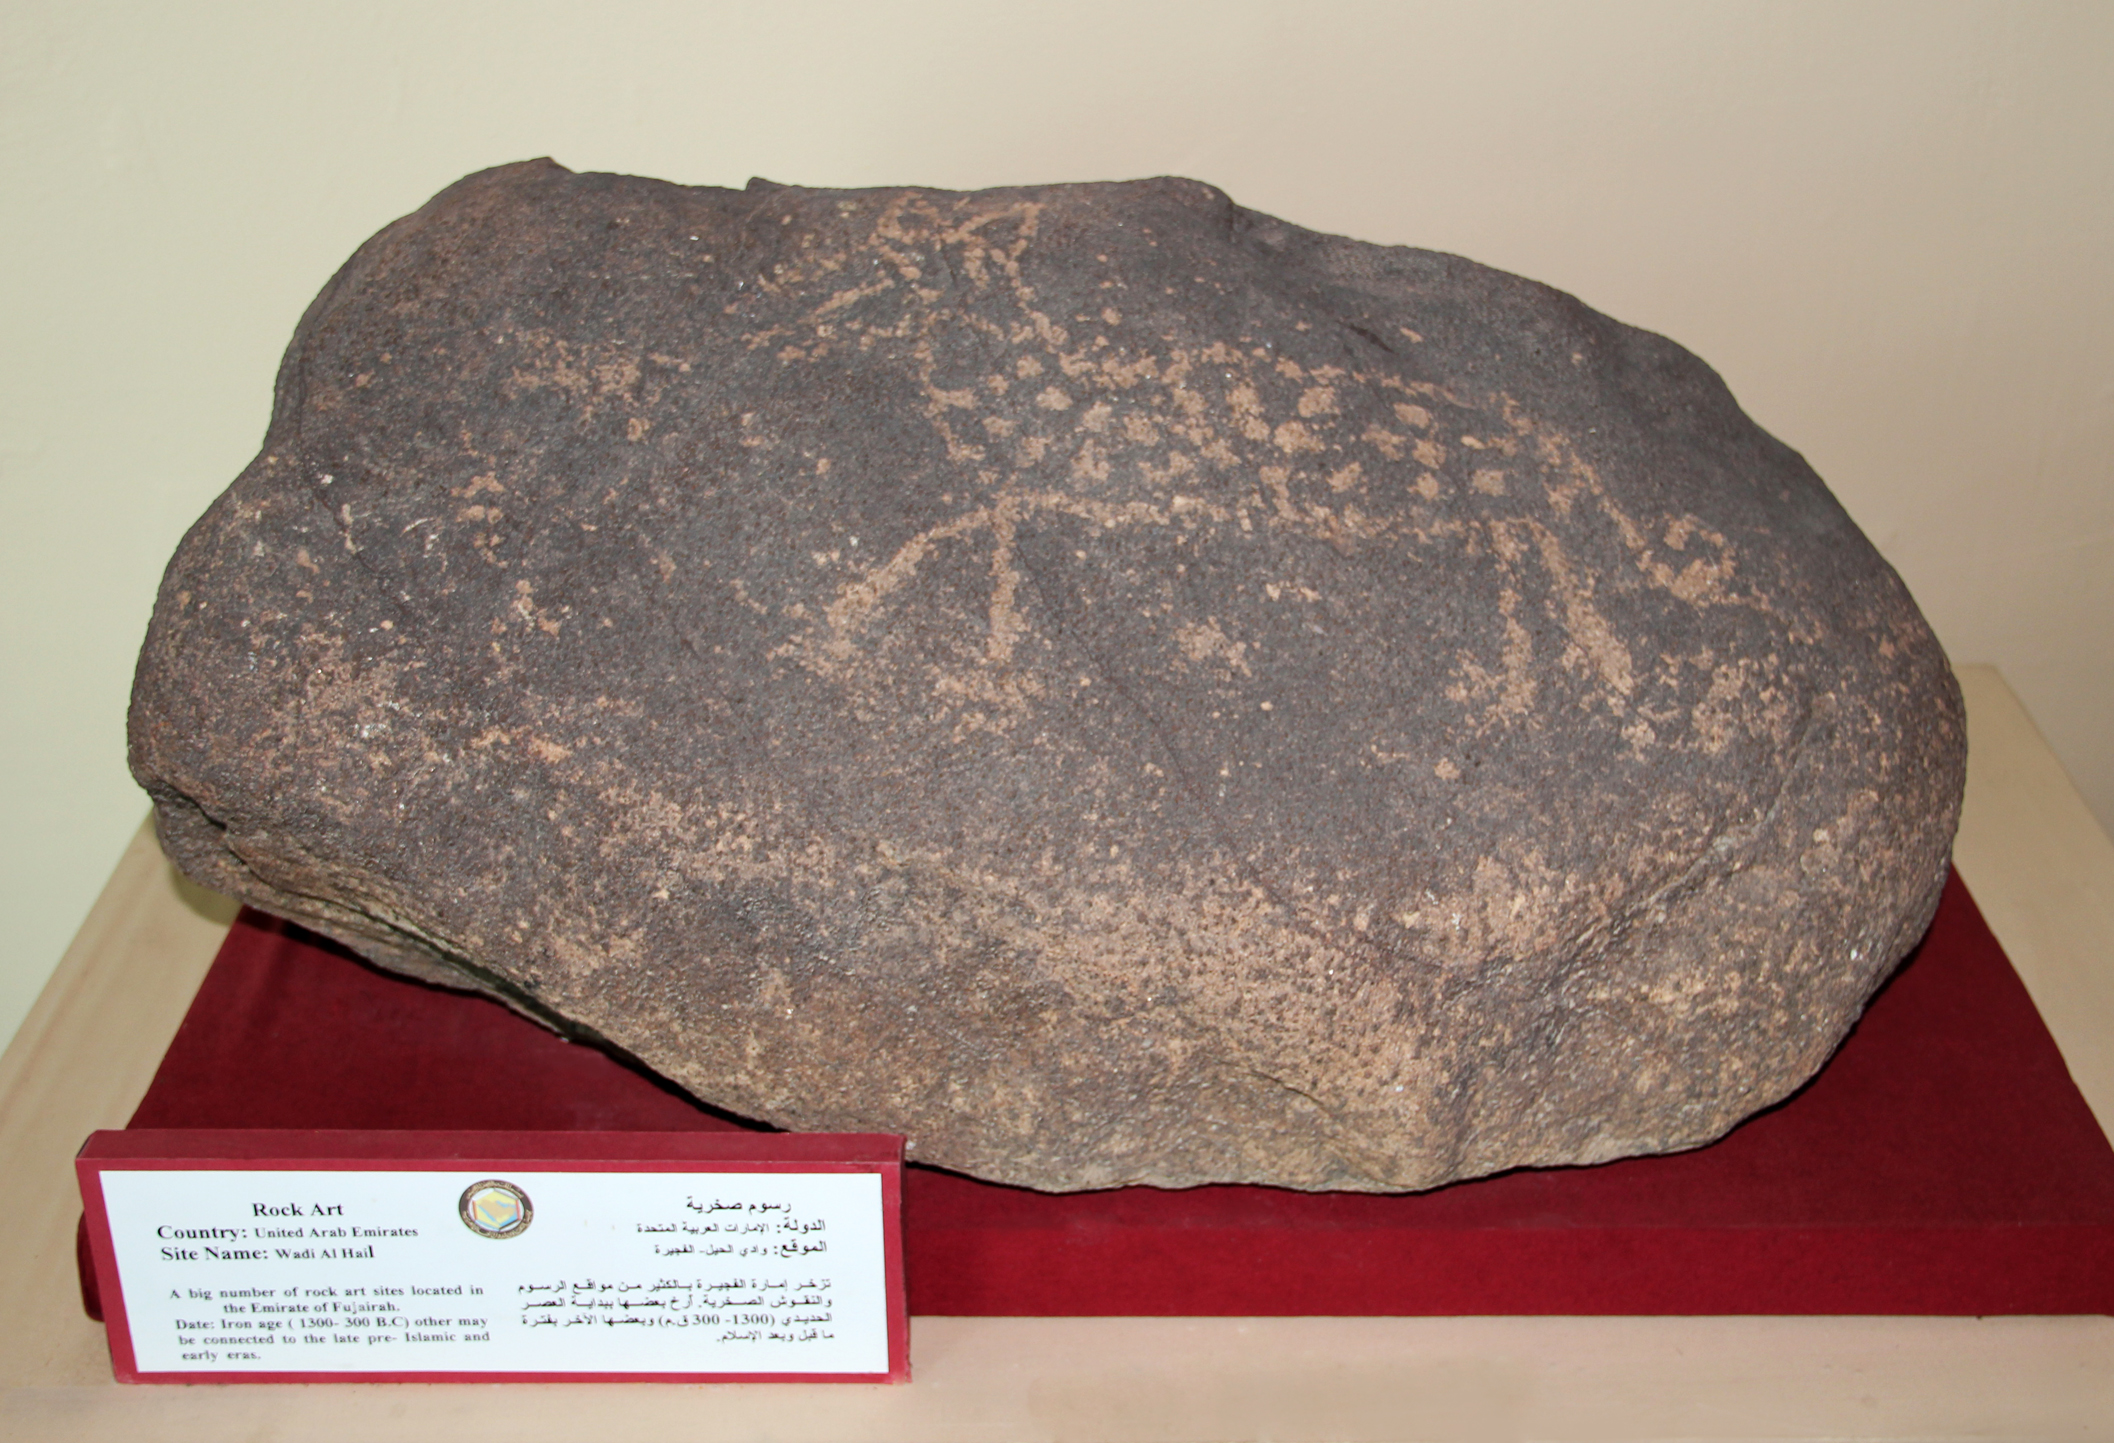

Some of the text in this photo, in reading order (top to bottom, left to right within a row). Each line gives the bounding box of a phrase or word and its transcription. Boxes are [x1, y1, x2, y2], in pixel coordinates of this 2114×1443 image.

[252, 1202, 344, 1217] Rock Art
[686, 1196, 791, 1215] رسوم صخرية
[637, 1223, 677, 1233] المتحدة
[682, 1221, 719, 1235] العربية
[776, 1217, 825, 1234] الدولة:
[157, 1225, 418, 1242] Country: United Arab Emirates
[161, 1245, 374, 1260] Site Name: Wadi Al Hail
[655, 1244, 695, 1256] الفجيرة
[739, 1245, 768, 1257] وادي
[774, 1238, 827, 1258] الموقع:
[518, 1280, 566, 1294] الرسوم
[573, 1279, 613, 1294] مواقع
[618, 1282, 642, 1292] من
[648, 1278, 693, 1292] بالكثير
[697, 1278, 746, 1291] الفجيرة
[794, 1279, 831, 1291] تزخر
[170, 1285, 483, 1300] A big number of rock art sites located in
[223, 1301, 400, 1315] the Emirate of Fujairah.
[522, 1297, 566, 1310] العصر
[571, 1296, 614, 1310] ببداية
[618, 1297, 666, 1310] بعضها
[698, 1294, 764, 1308] الصخرية.
[770, 1295, 832, 1308] والنقوش
[176, 1319, 214, 1329] Date:
[221, 1319, 251, 1329] Iron
[258, 1321, 282, 1331] age
[345, 1317, 370, 1328] 300
[377, 1317, 409, 1329] B.C)
[415, 1316, 452, 1326] other
[458, 1319, 487, 1328] may
[522, 1315, 558, 1327] بفترة
[603, 1315, 654, 1327] وبعضها
[781, 1312, 832, 1326] الحديدي
[179, 1331, 490, 1345] be connected to the late pre- Islamic and
[768, 1332, 794, 1342] وبعد
[799, 1329, 818, 1341] قبل
[822, 1330, 834, 1339] ما
[182, 1350, 218, 1362] early
